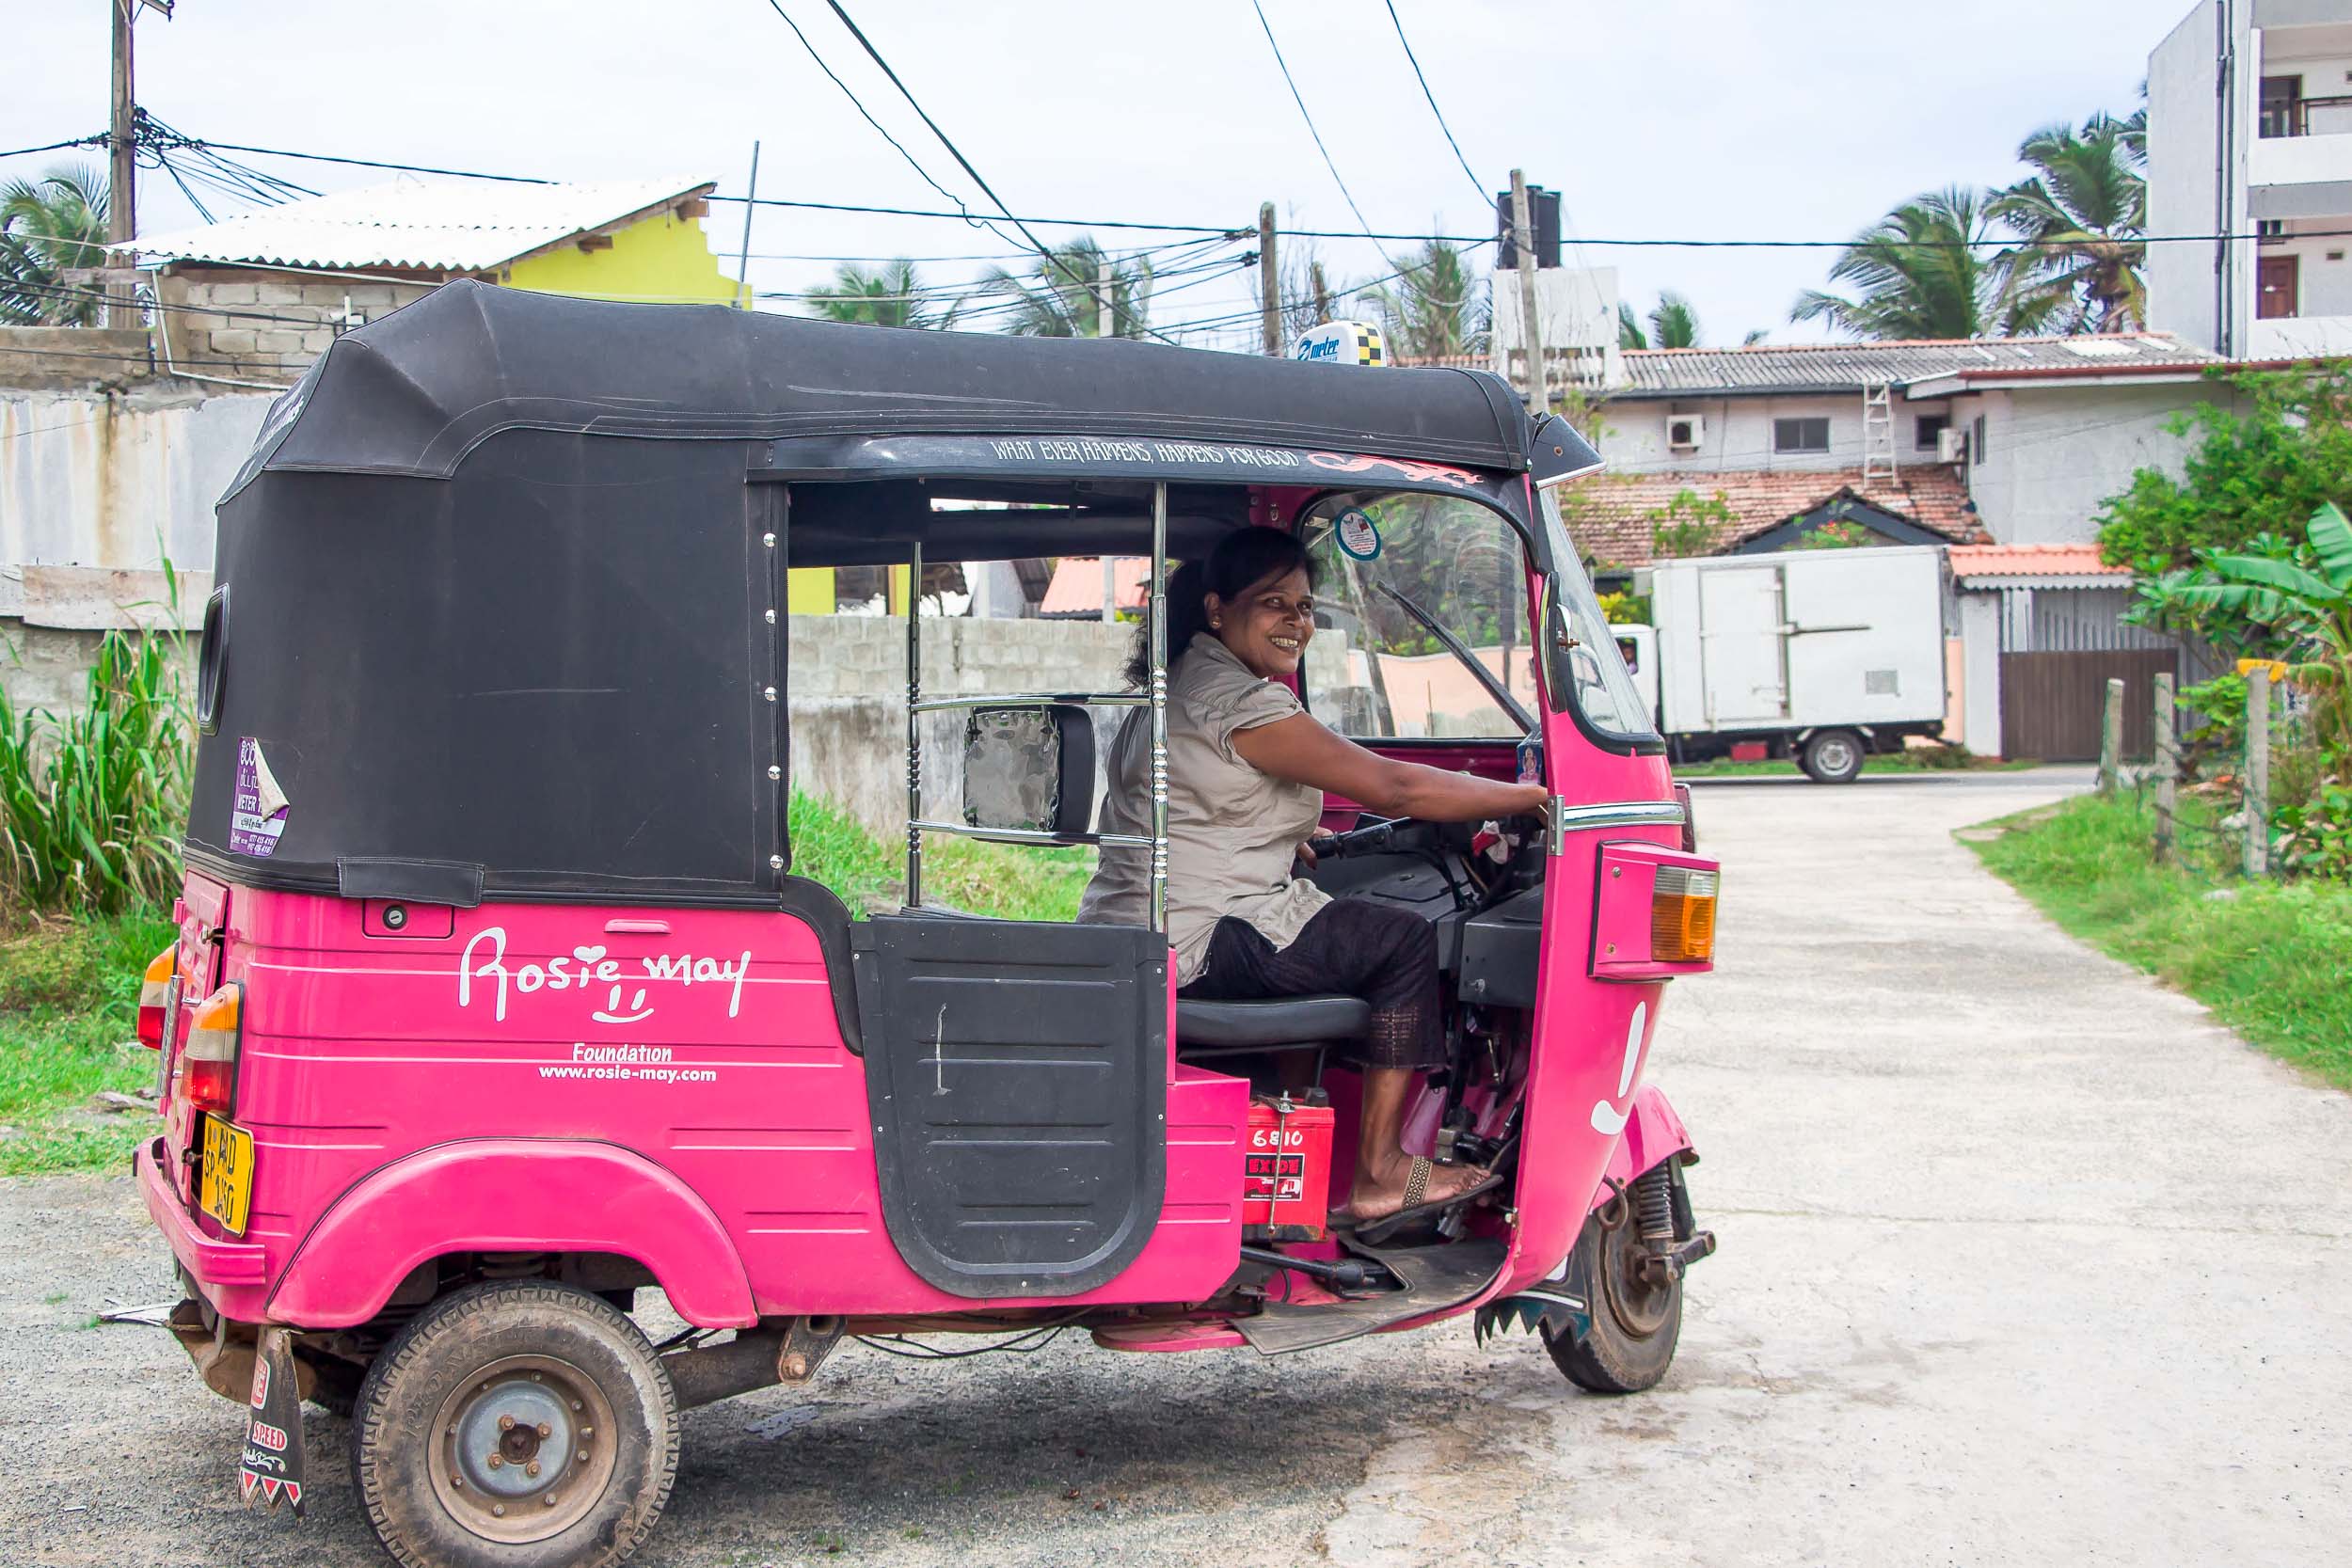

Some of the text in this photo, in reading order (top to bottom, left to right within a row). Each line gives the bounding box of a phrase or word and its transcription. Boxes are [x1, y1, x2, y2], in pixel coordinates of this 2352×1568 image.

[990, 441, 1299, 467] WHAT EVER HAPPENS, HAPPENS FOR GOOD
[458, 927, 622, 1022] Rosie
[572, 1042, 673, 1063] Foundation
[538, 1065, 717, 1084] www.rosie-may.com
[1248, 1158, 1299, 1174] EXIDE
[253, 1421, 286, 1450] SPEED
